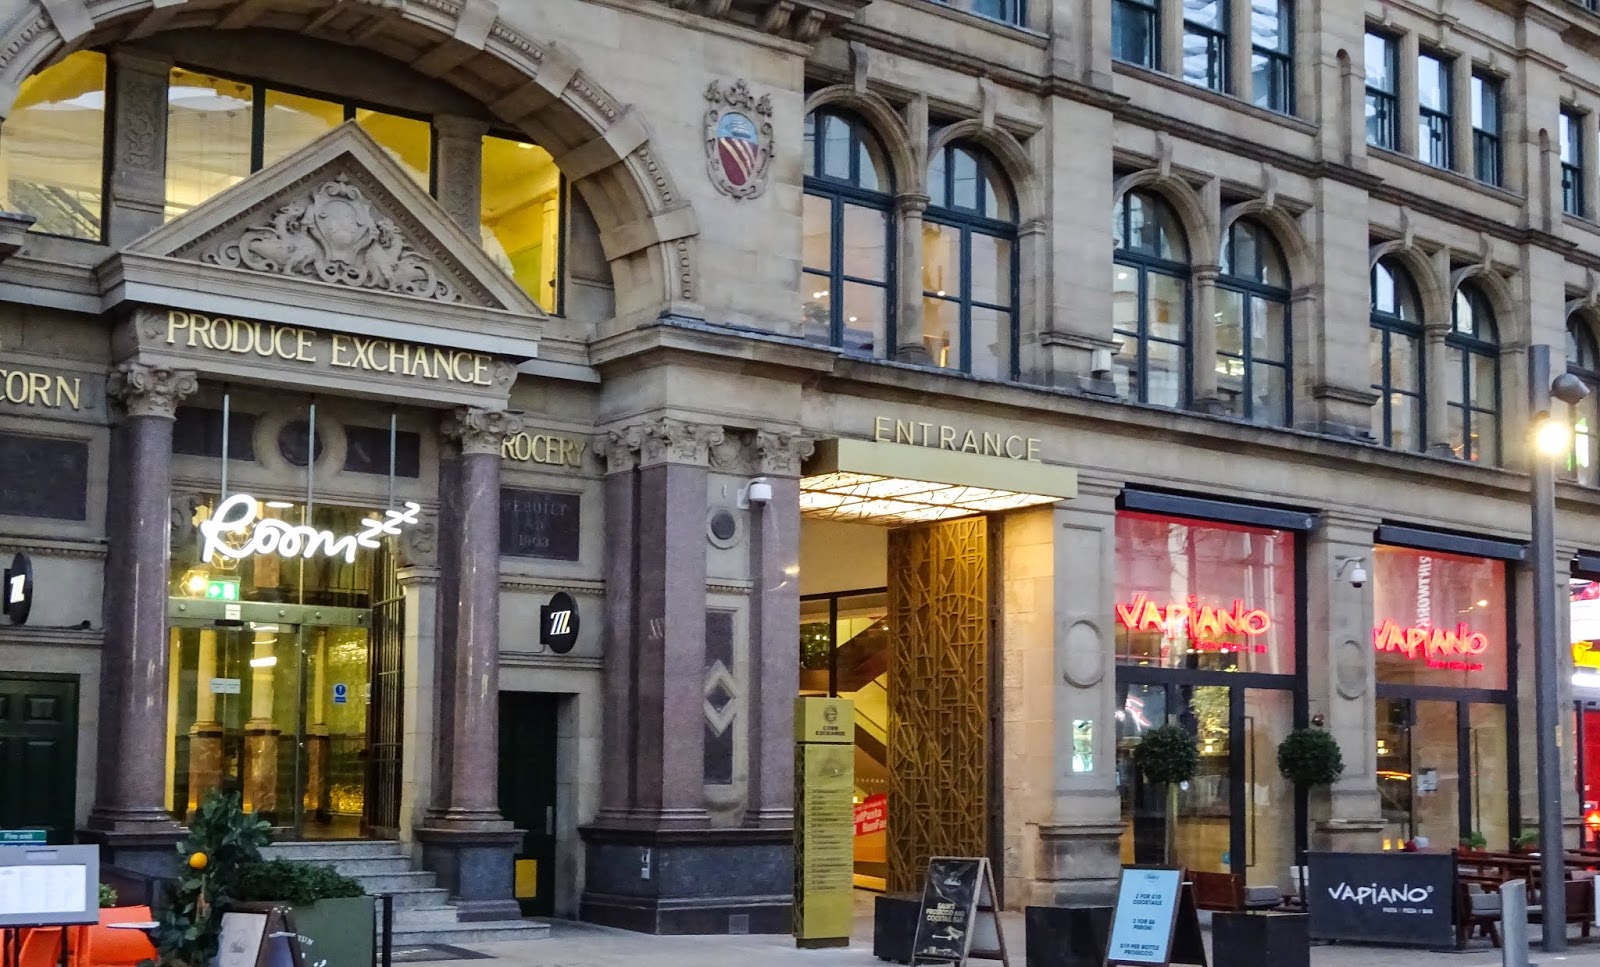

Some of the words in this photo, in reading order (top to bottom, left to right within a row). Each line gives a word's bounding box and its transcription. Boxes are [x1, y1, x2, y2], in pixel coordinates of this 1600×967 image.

[166, 311, 317, 362] PRODUCE
[330, 334, 492, 386] EXCHANGE
[875, 416, 1041, 462] ENTRANCE
